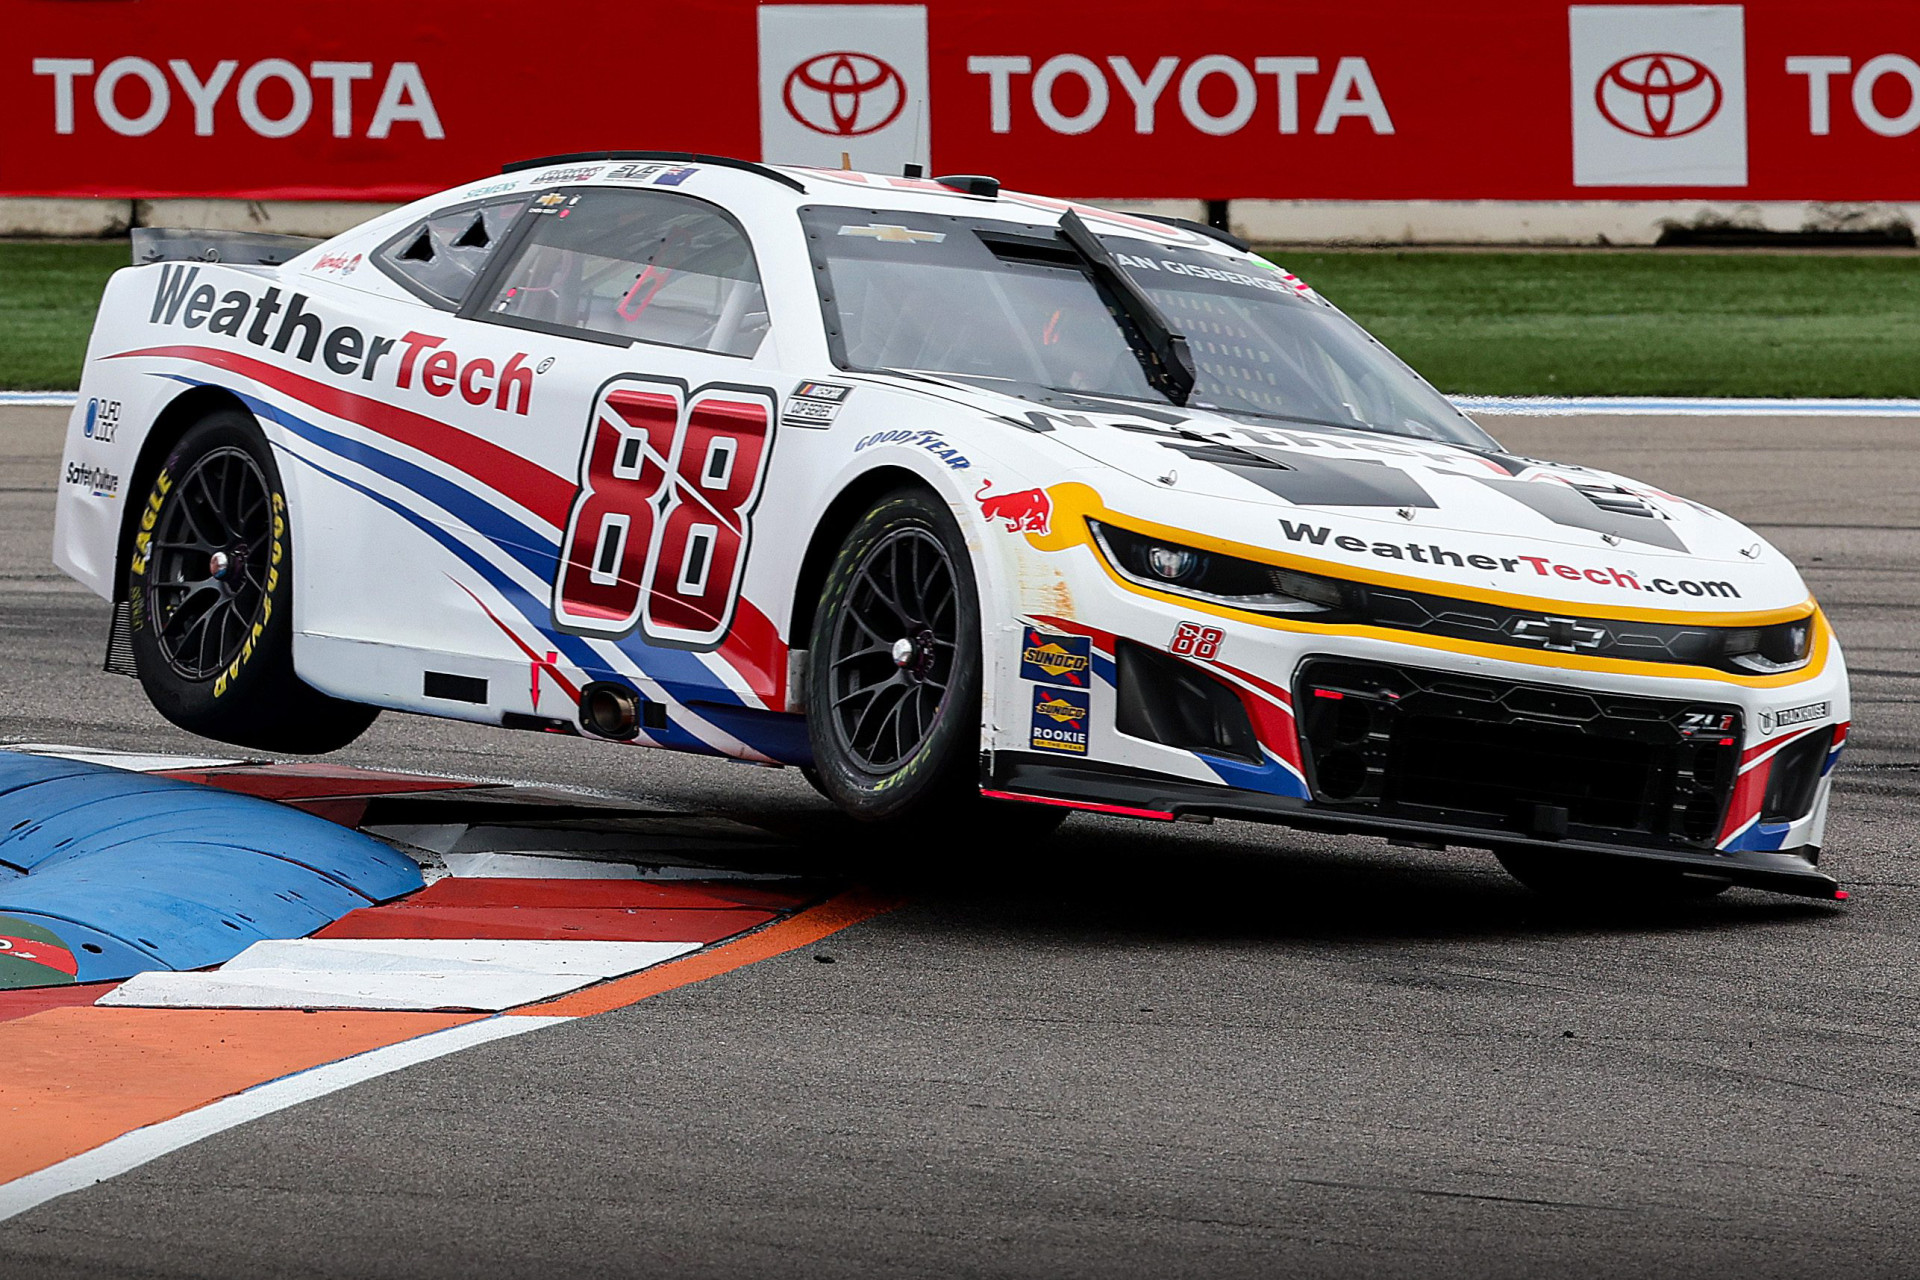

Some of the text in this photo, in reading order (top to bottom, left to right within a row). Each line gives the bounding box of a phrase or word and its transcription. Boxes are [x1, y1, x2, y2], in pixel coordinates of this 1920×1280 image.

[33, 56, 445, 139] TOYOTA
[967, 54, 1395, 135] TOYOTA
[854, 430, 971, 470] GOODYEAR
[132, 467, 173, 575] EAGLE
[551, 372, 778, 653] 88
[1026, 649, 1085, 669] SUNOCO
[1168, 620, 1226, 661] 88
[1039, 703, 1083, 718] SUNOCO
[1678, 713, 1735, 731] ZL1
[1033, 727, 1086, 743] ROOKIE
